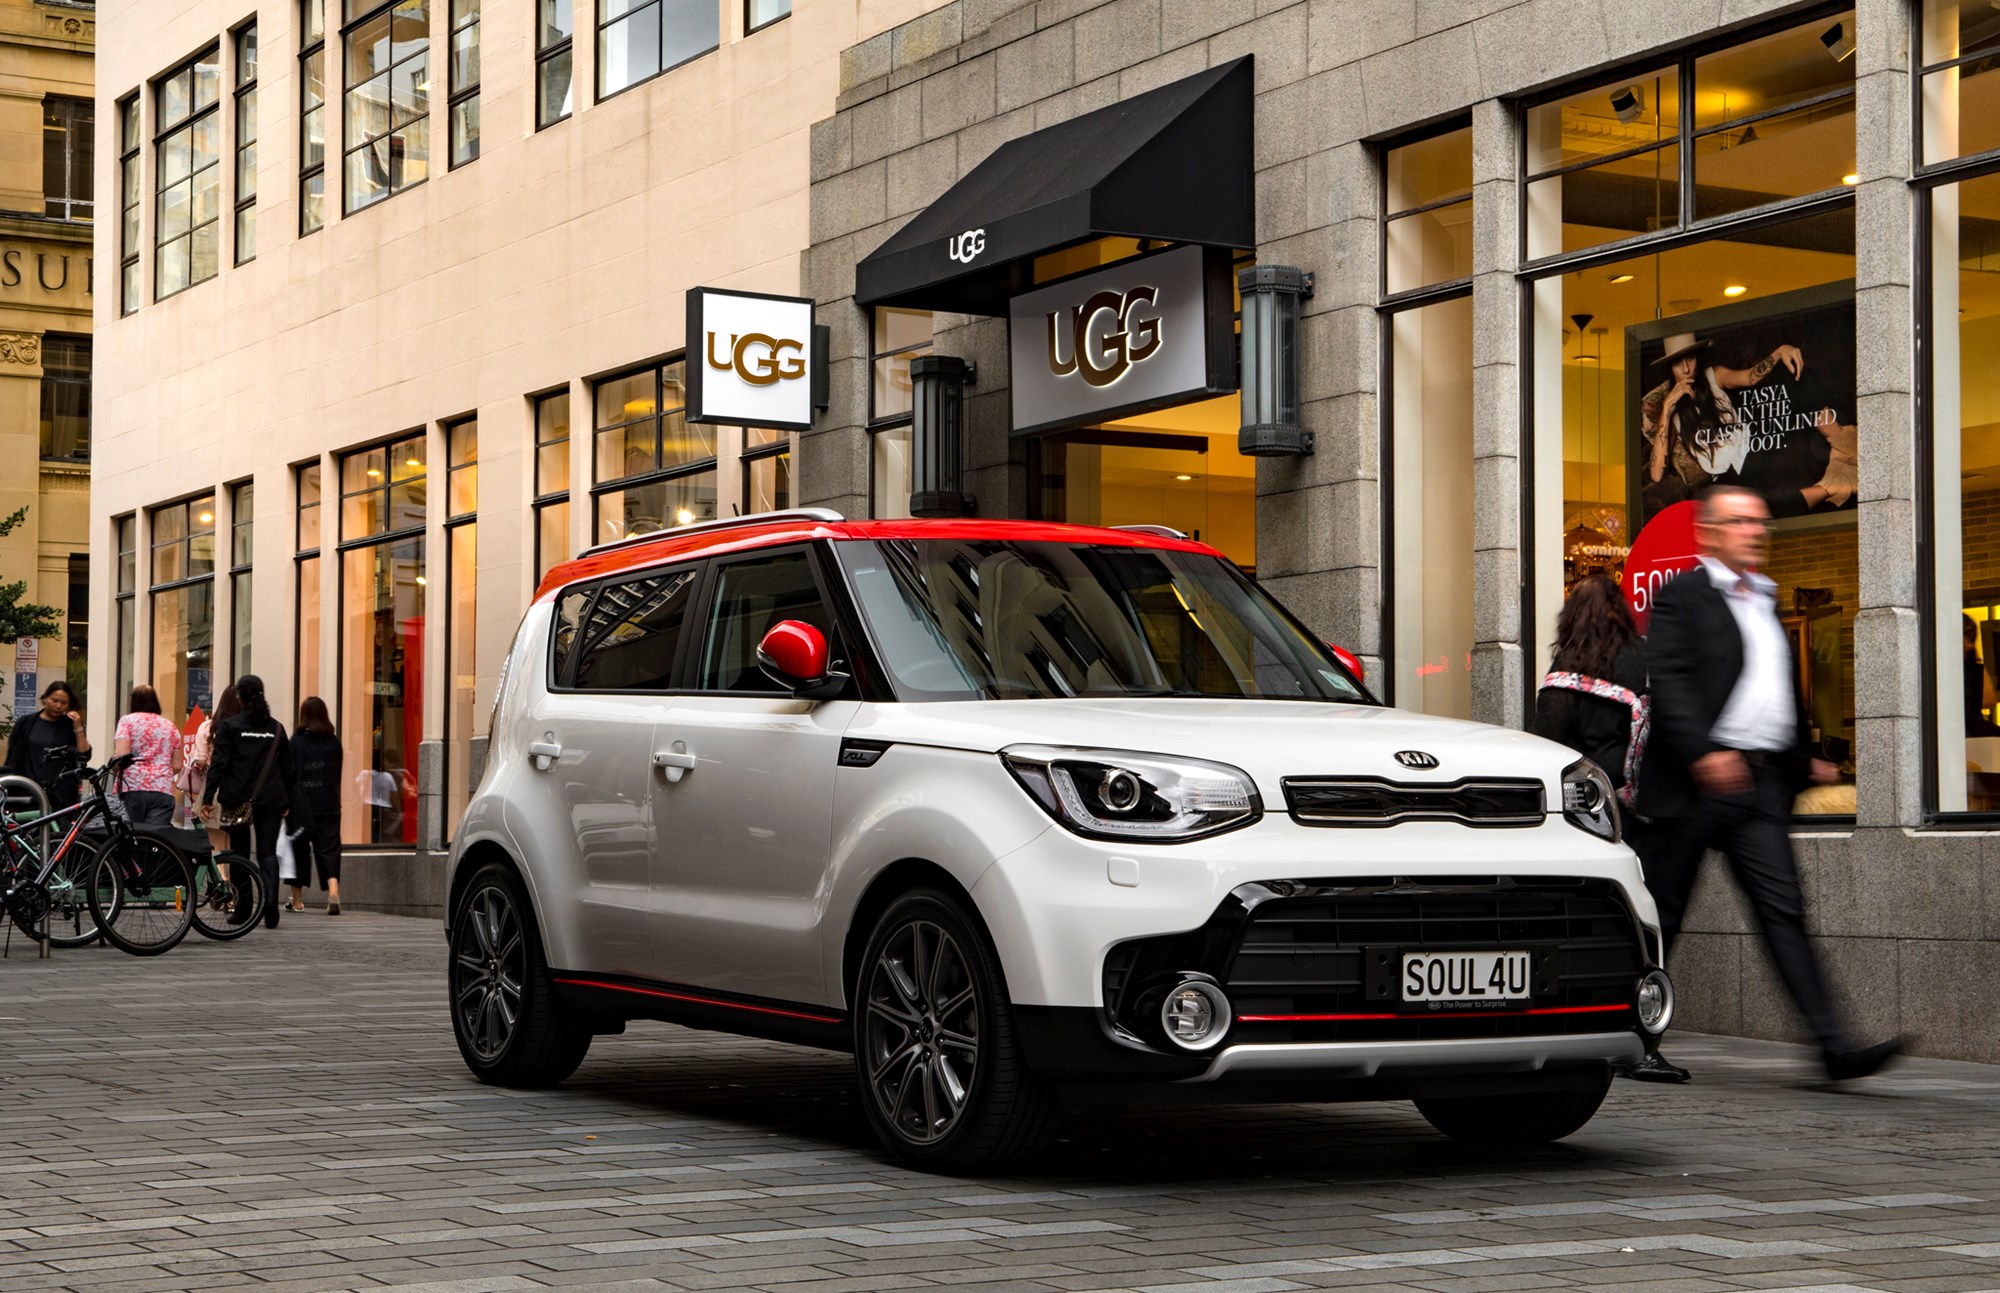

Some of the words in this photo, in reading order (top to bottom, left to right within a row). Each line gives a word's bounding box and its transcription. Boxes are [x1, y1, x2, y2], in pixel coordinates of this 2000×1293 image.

[949, 228, 986, 264] UGG
[1046, 285, 1163, 388] UGG
[706, 331, 806, 386] UGG
[1737, 405, 1754, 423] IN
[1757, 399, 1792, 419] THE
[1739, 384, 1789, 406] TASYA
[1694, 420, 1758, 446] CLASSIC
[1760, 408, 1837, 436] UNLINED
[1397, 751, 1437, 766] KIA
[1406, 957, 1526, 996] SOUL4U
[1455, 1000, 1473, 1008] Power
[1482, 1000, 1507, 1008] Surprise
